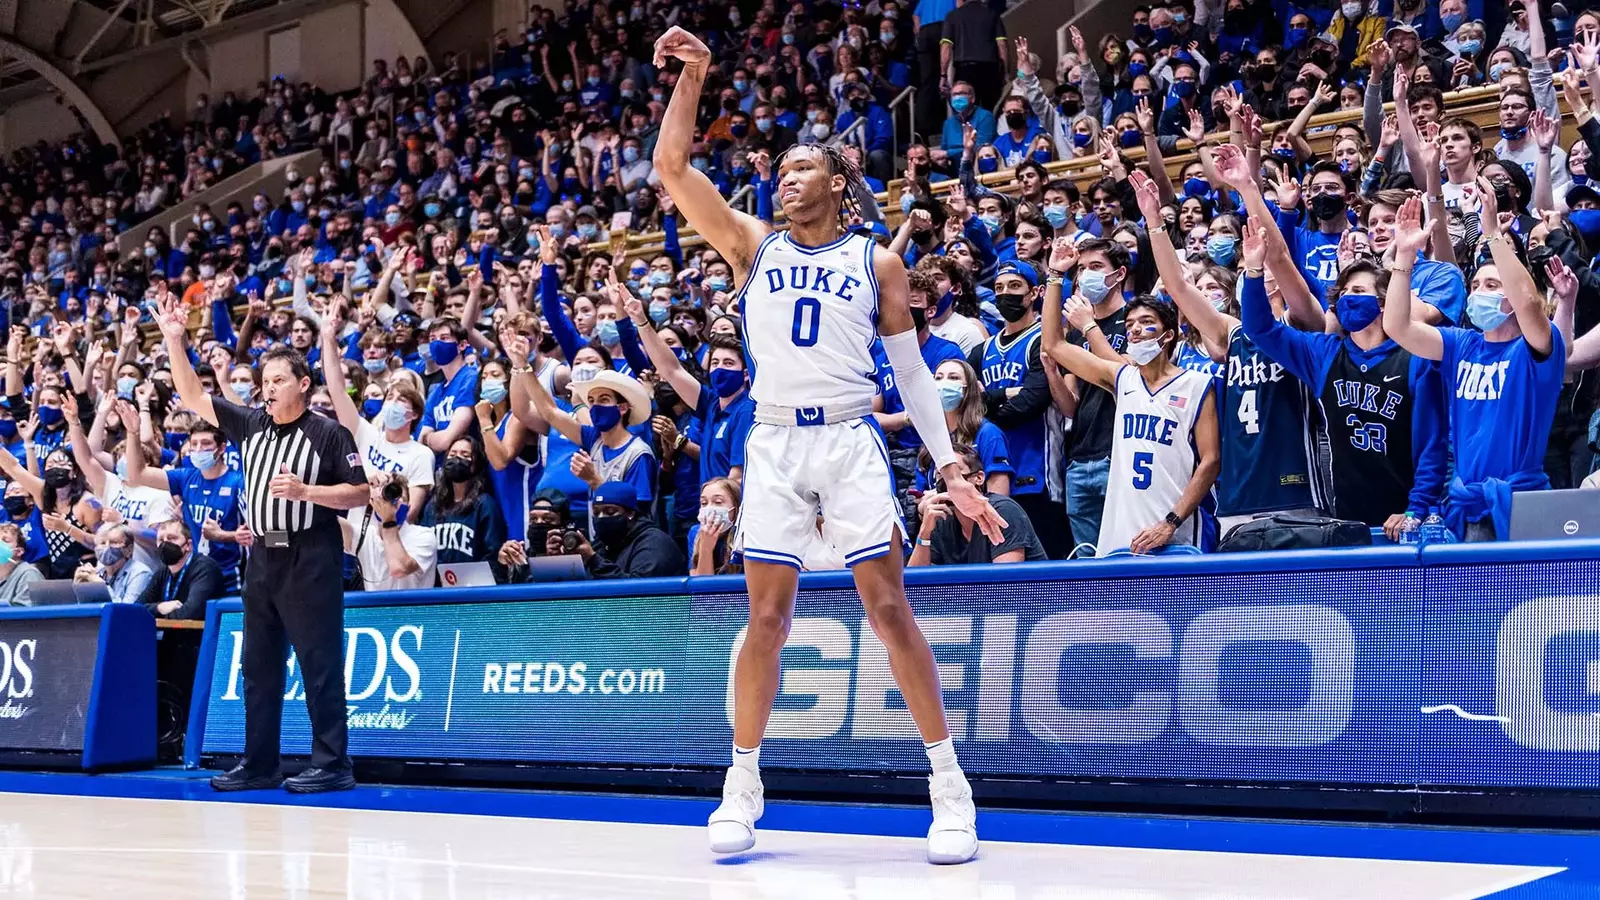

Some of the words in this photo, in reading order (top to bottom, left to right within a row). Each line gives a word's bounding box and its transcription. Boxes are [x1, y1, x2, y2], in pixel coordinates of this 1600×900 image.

[765, 266, 862, 302] DUKE
[791, 297, 821, 347] 0
[982, 361, 1023, 387] DUKE
[1227, 352, 1285, 387] Duke
[1123, 413, 1178, 446] DUKE
[1237, 389, 1260, 435] 4
[1346, 413, 1387, 456] 33
[1132, 451, 1154, 490] 5
[430, 522, 475, 557] UKE
[482, 661, 666, 695] REEDS.com
[725, 604, 1357, 748] GEICO
